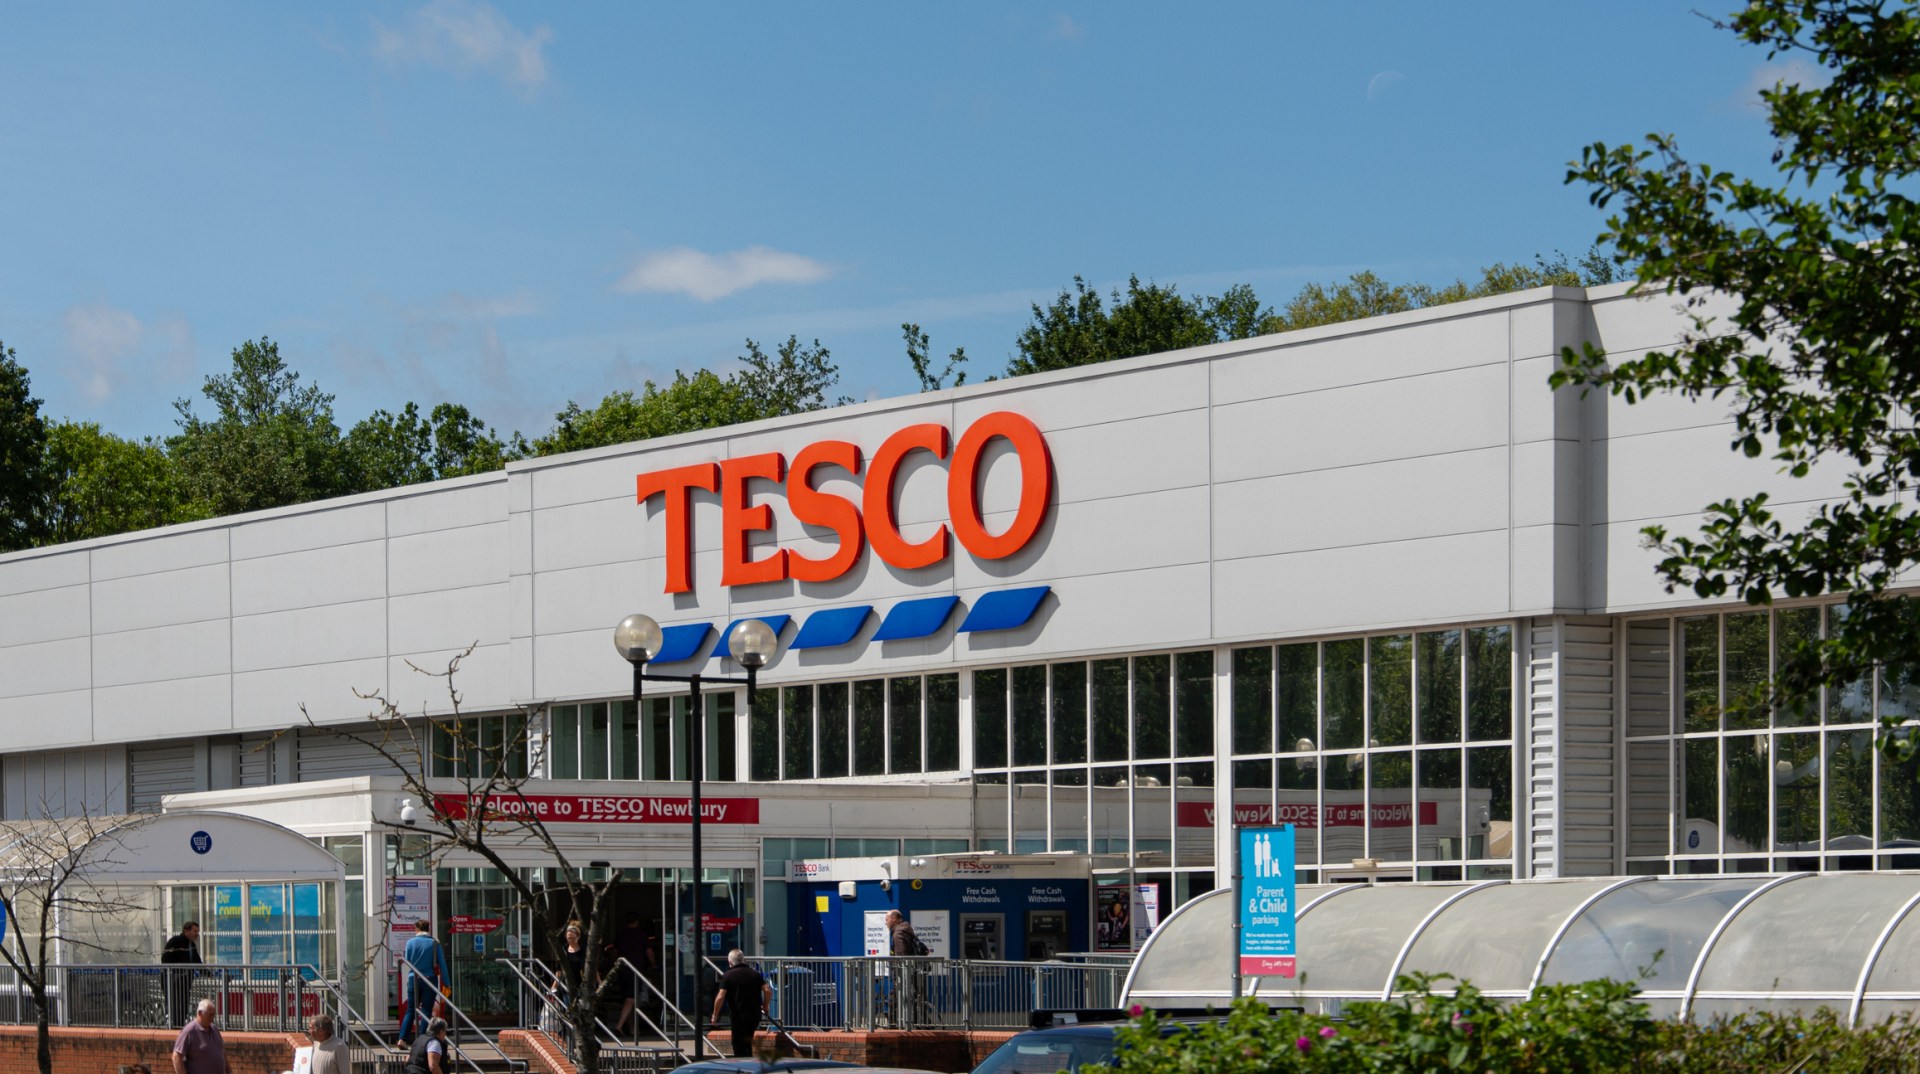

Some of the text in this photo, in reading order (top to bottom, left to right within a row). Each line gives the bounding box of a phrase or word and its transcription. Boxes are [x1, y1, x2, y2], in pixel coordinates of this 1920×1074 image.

[637, 411, 1053, 594] TESCO
[469, 796, 548, 815] Welcome
[554, 800, 572, 815] to
[578, 798, 644, 813] TESCO
[794, 863, 830, 873] TESCO Bank
[956, 861, 991, 870] TESCO
[966, 887, 997, 895] Free Cash
[1032, 887, 1062, 895] Free Cash
[1256, 886, 1284, 897] Parent
[218, 891, 230, 904] Our
[1028, 895, 1066, 903] Withdrawals
[1249, 898, 1287, 913] & Child
[1252, 915, 1279, 927] parking
